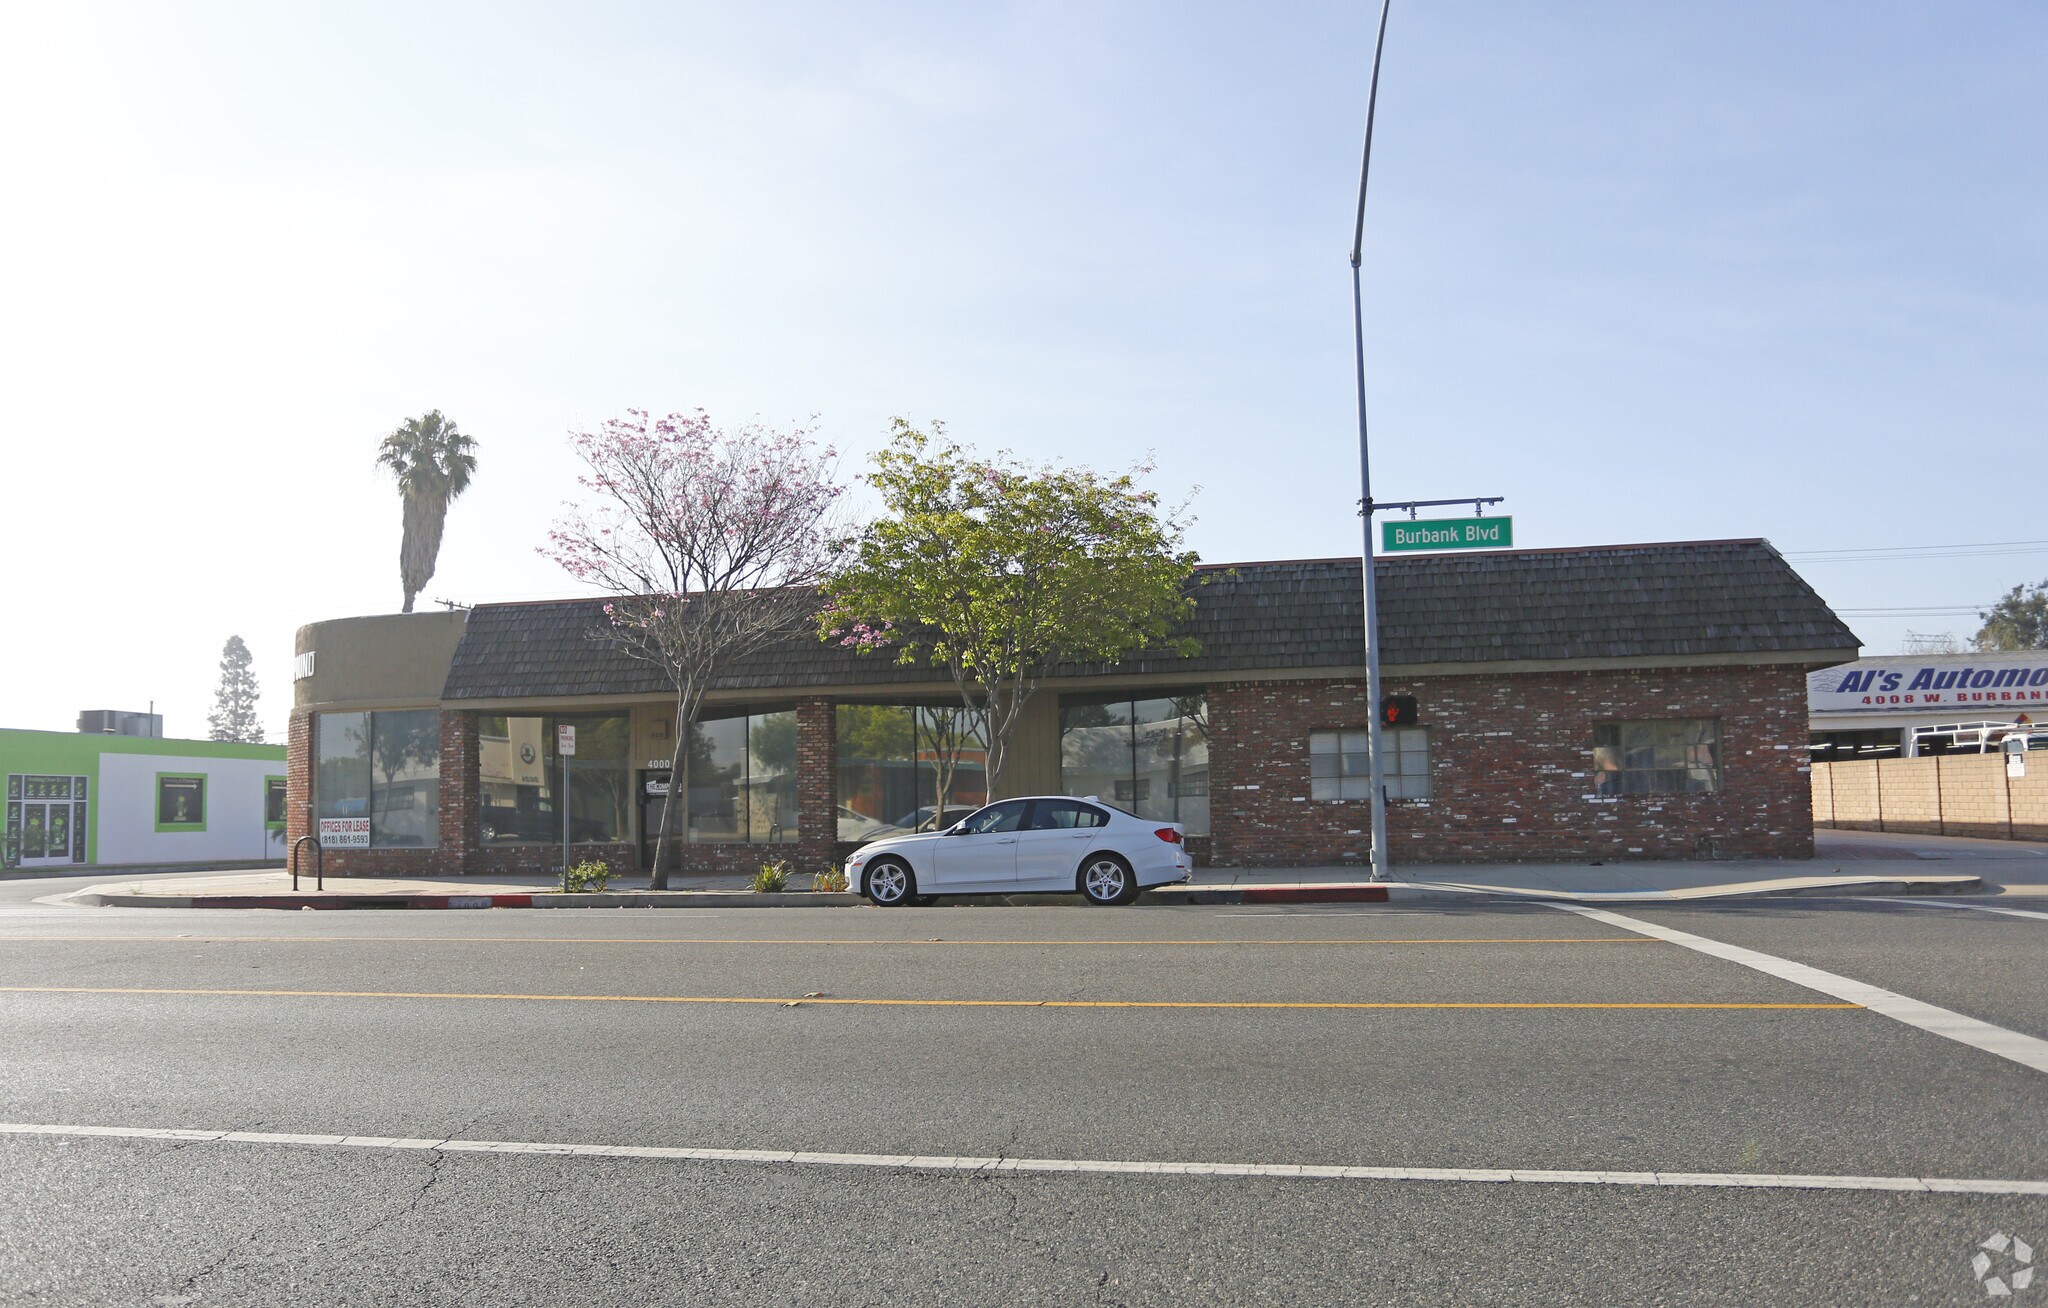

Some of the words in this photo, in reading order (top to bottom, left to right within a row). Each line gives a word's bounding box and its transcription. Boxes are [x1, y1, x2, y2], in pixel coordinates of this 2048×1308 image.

[1395, 526, 1459, 545] Burbank
[1465, 524, 1499, 542] Blvd
[1836, 669, 1903, 693] Al's
[1907, 667, 2048, 690] Automo
[1861, 694, 1914, 705] 4008
[1924, 693, 1947, 703] W.
[1957, 690, 2048, 702] BURBAN
[647, 759, 670, 769] 4000
[321, 820, 341, 833] OFFICES
[342, 820, 353, 833] FOR
[353, 820, 369, 832] LEASE
[322, 835, 338, 845] (818)
[339, 835, 369, 844] 861-9593
